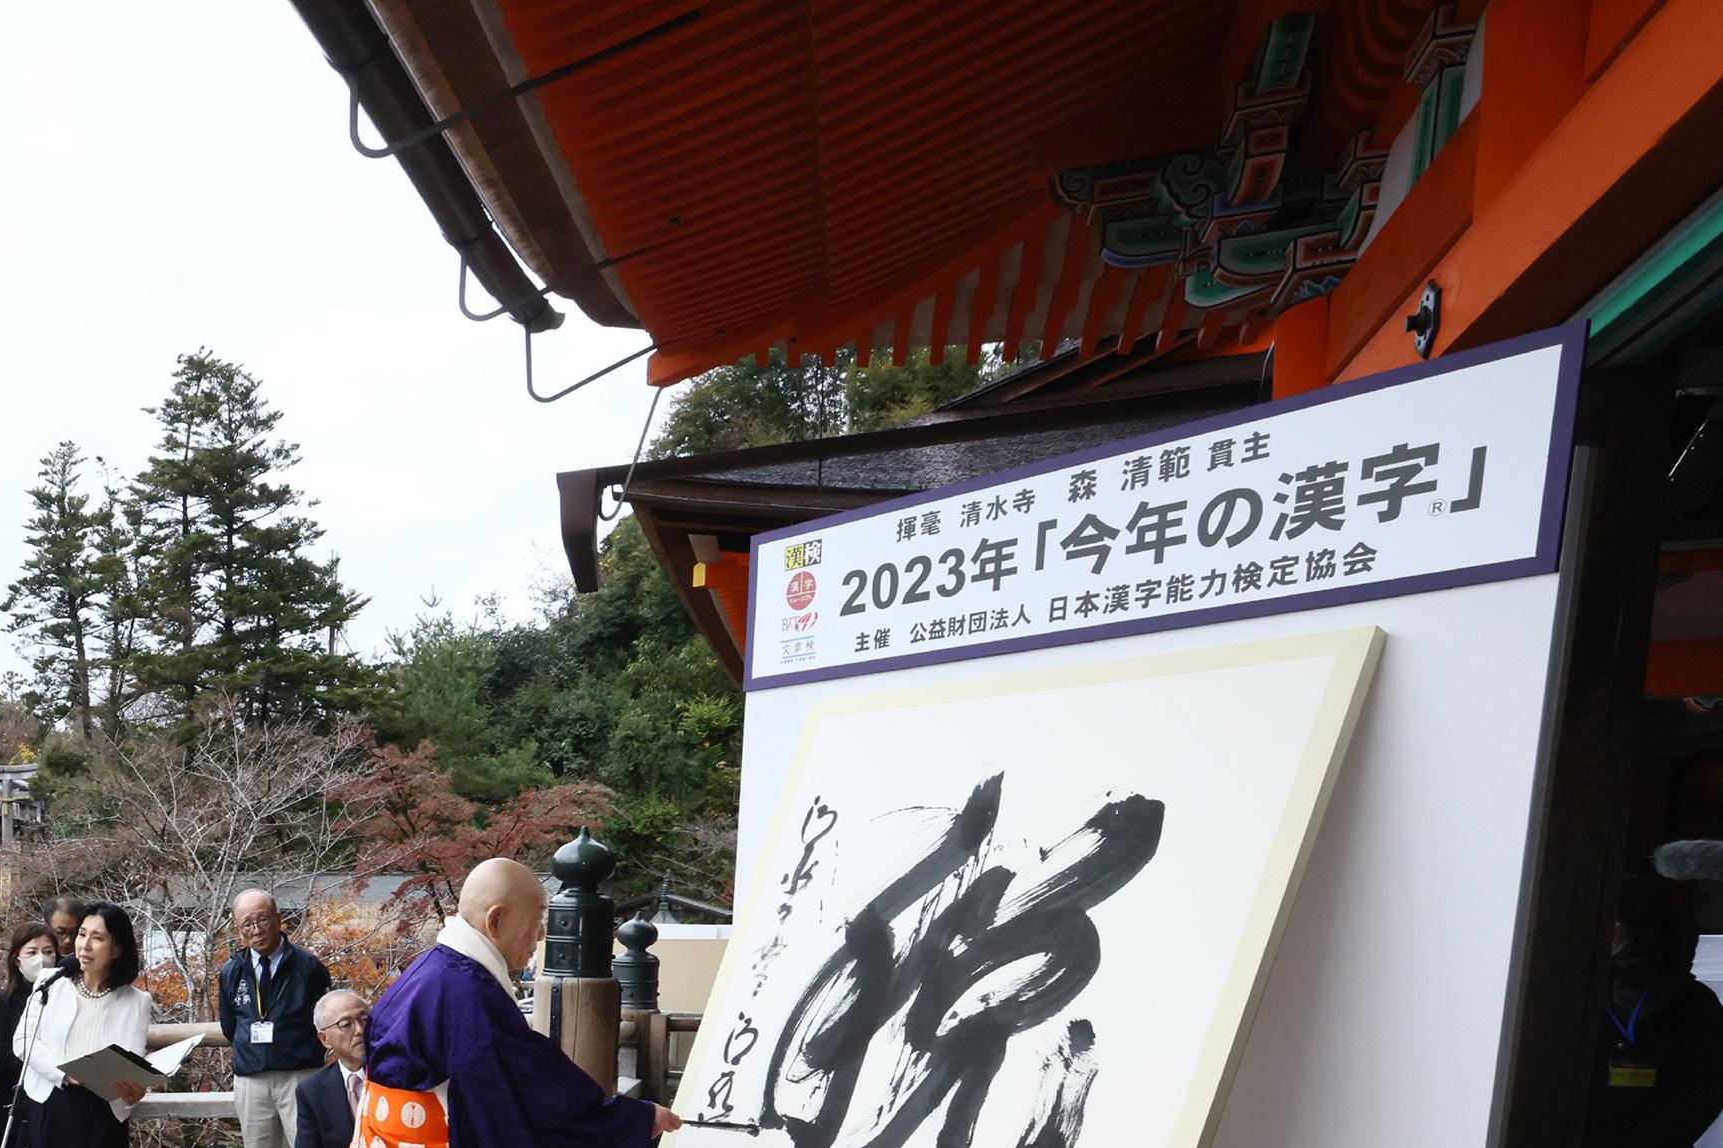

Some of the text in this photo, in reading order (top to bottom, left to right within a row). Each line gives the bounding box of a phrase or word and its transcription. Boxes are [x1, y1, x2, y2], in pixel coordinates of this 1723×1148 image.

[895, 431, 1272, 543] 揮毫 清水寺 森 清範 貫主
[785, 540, 822, 570] 漢検
[854, 541, 1378, 653] 主催 公益財団法人 日本漢字能力検定協会
